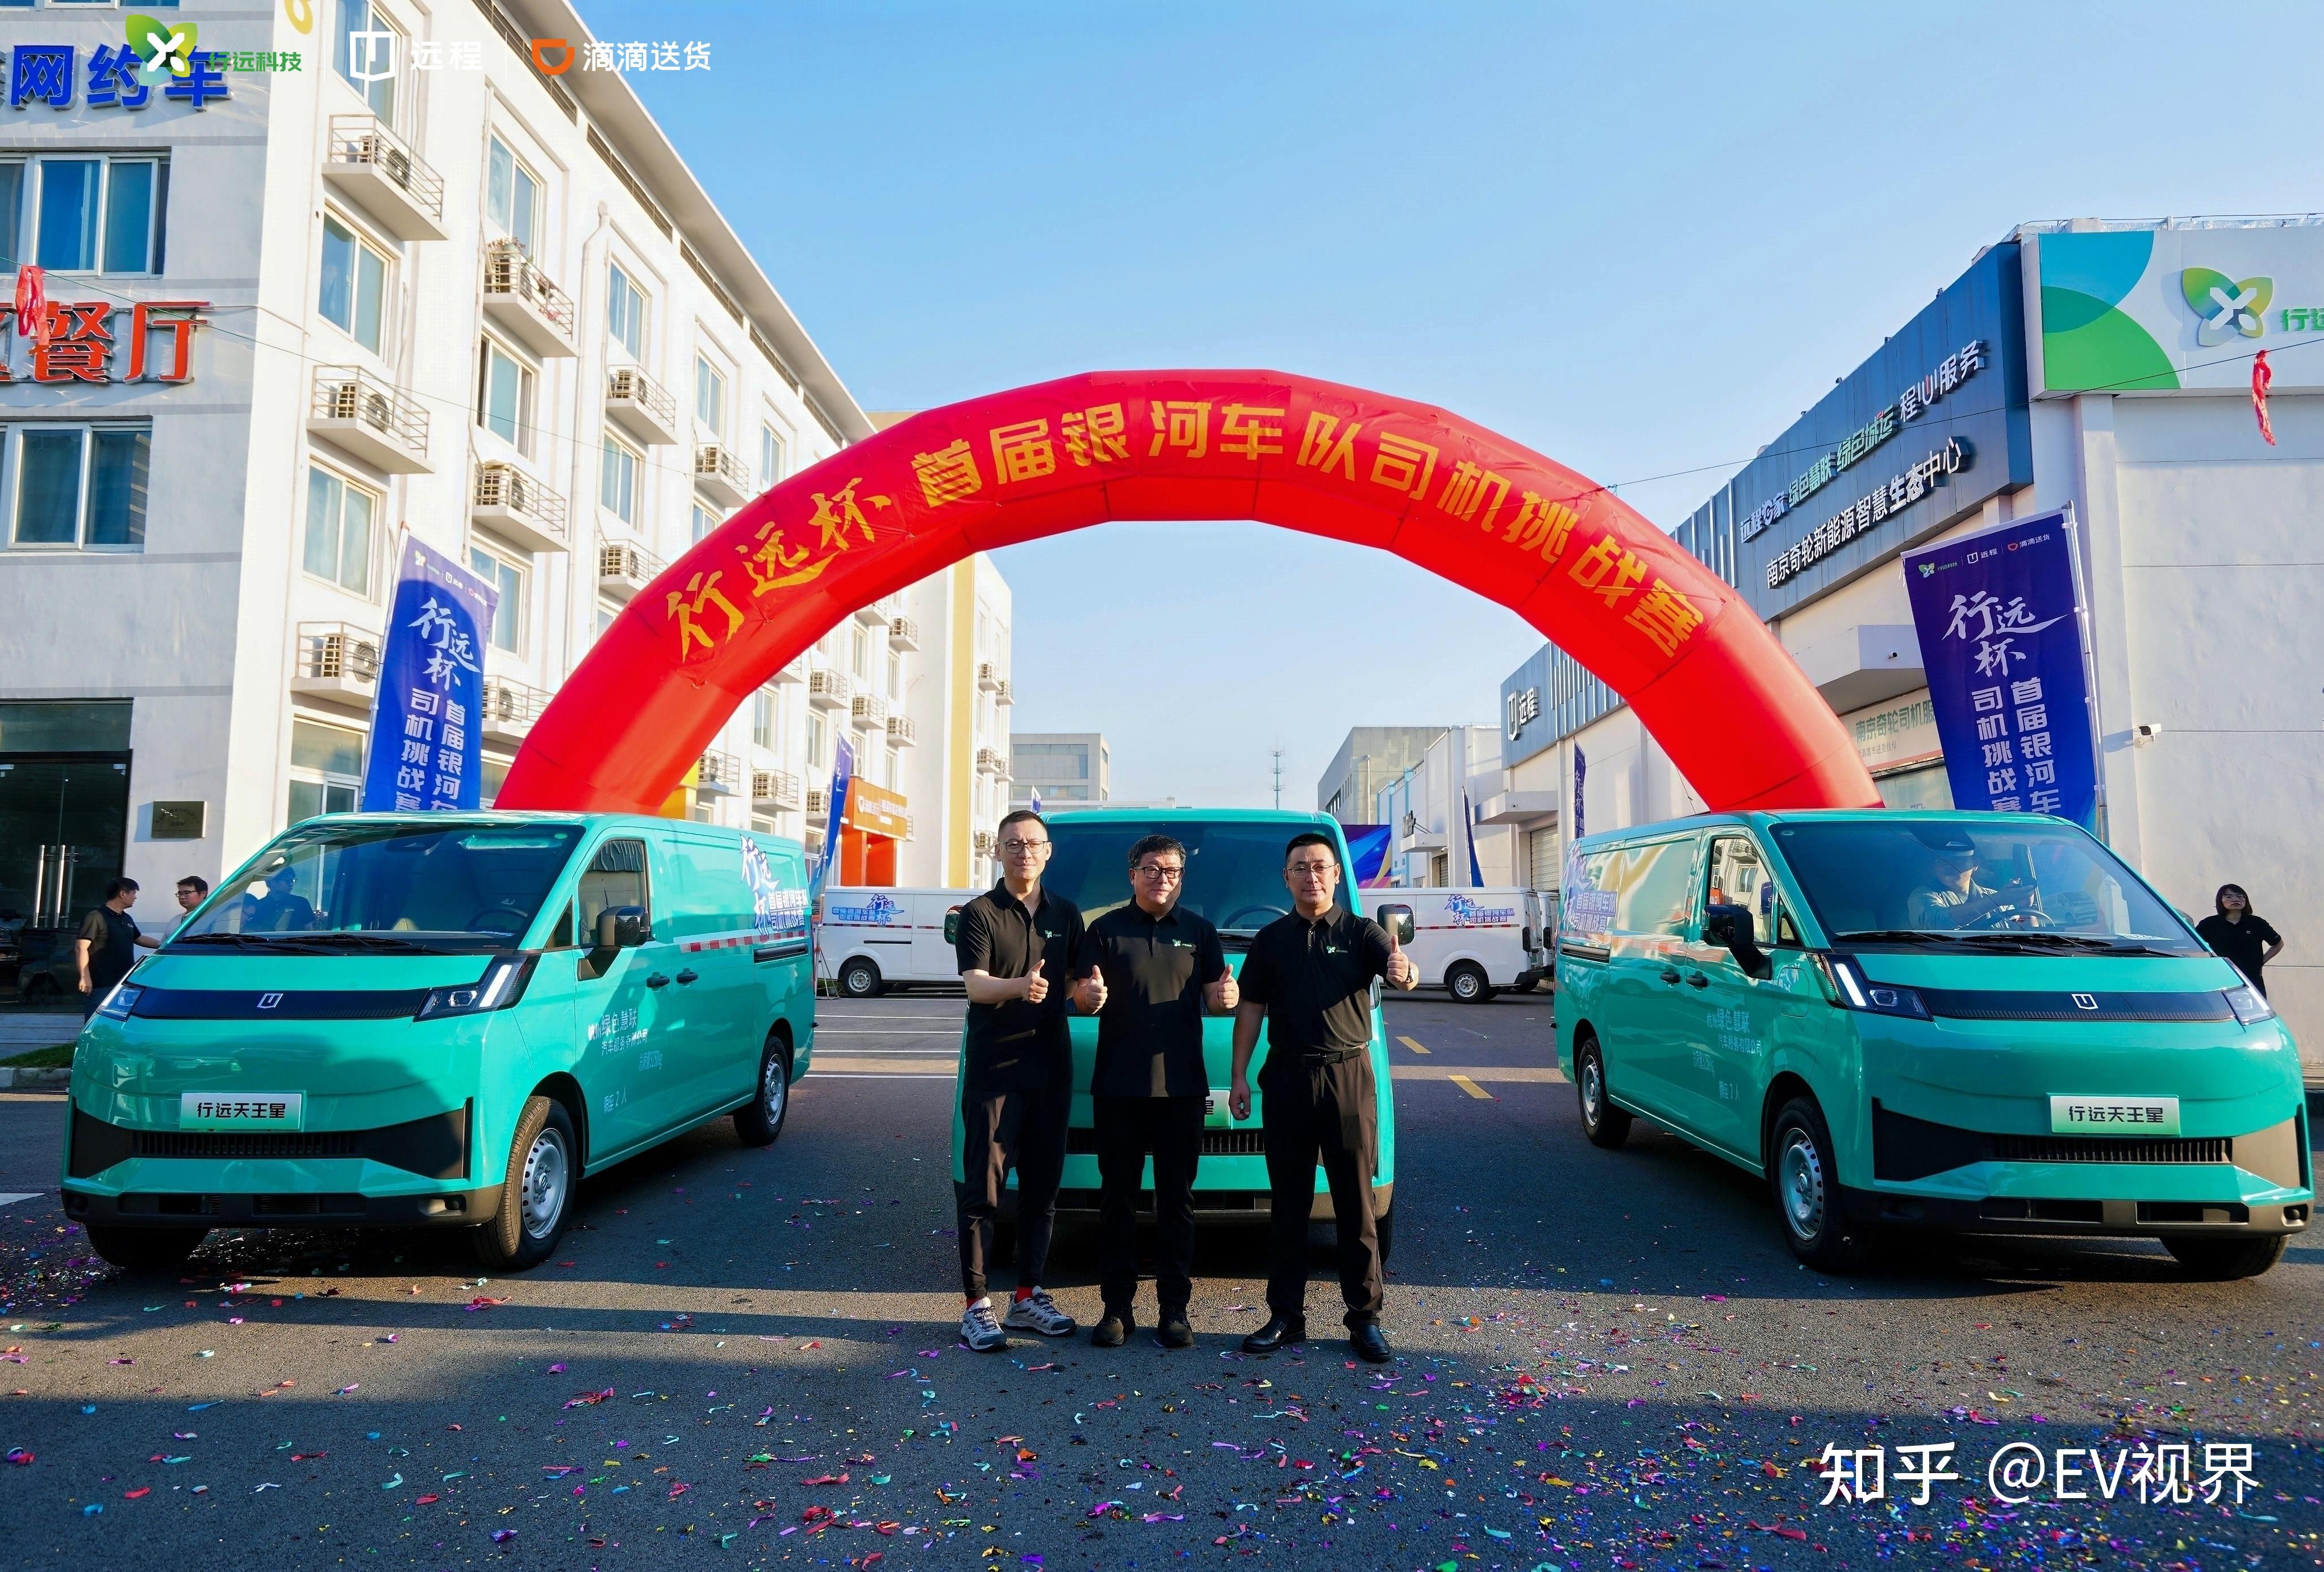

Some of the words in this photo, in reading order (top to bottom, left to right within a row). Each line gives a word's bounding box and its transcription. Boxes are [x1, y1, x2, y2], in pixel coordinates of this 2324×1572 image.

[10, 44, 229, 109] 网约车
[0, 301, 213, 382] 餐厅
[666, 477, 892, 663] 行远杯
[911, 401, 1704, 658] 首届银河车队司机挑战赛
[1766, 436, 1962, 589] 南京奇轮新能源智慧生态中心
[1980, 548, 1998, 560] 远程
[2019, 533, 2050, 548] 滴滴送货
[407, 597, 482, 674] 行远
[1941, 590, 2070, 643] 行远
[422, 649, 461, 692] 杯
[1975, 638, 2027, 677] 杯
[1519, 686, 1536, 727] 远程
[1855, 699, 1936, 744] 南京奇轮司机服
[1971, 685, 2023, 812] 司机挑战赛
[2010, 676, 2062, 814] 首届银河车
[768, 889, 809, 910] 首届银河车队
[1444, 894, 1485, 912] 行远
[1469, 908, 1515, 917] 首届银河车队
[1576, 892, 1616, 913] 首届银河车队
[1707, 1007, 1750, 1034] 杭州绿色慧联
[602, 1028, 648, 1056] 汽车服务有限公司
[1717, 1033, 1762, 1057] 汽车服务有限公司
[197, 1102, 286, 1119] 行远天王星
[2068, 1106, 2164, 1123] 行远天王星
